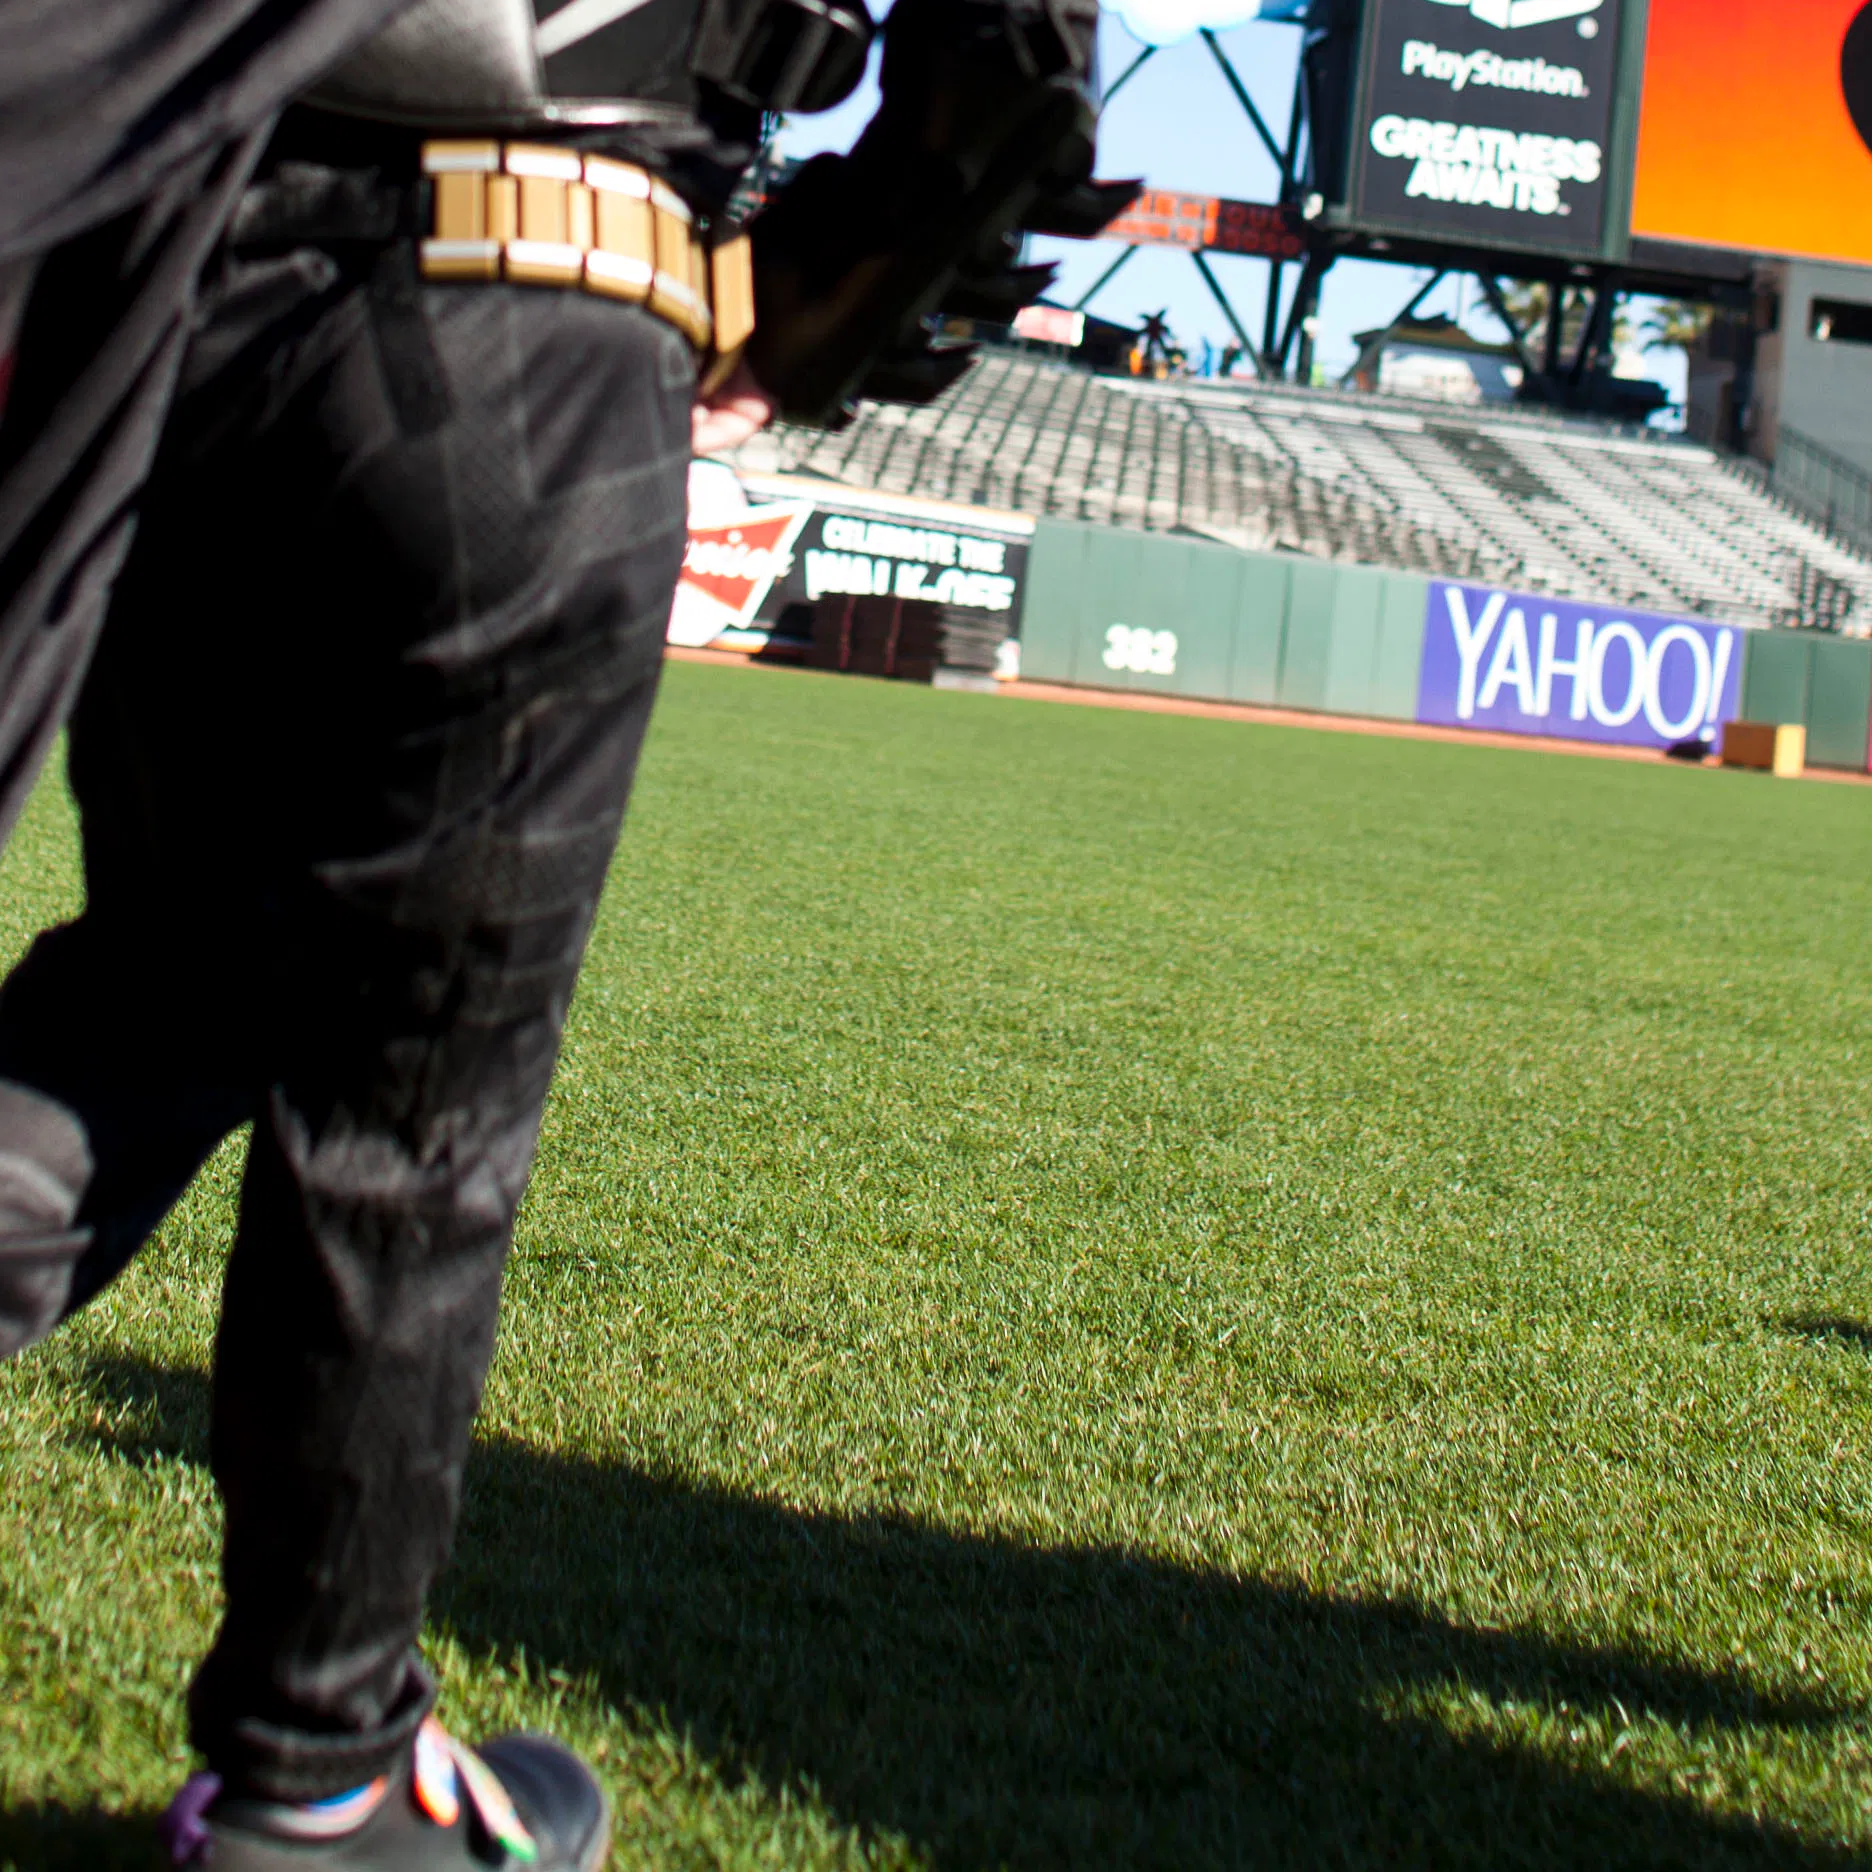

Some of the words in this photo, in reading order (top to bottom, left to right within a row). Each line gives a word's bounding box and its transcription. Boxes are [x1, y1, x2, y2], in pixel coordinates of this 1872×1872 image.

[1401, 39, 1587, 98] PlayStation
[1369, 114, 1602, 183] GREATNESS
[822, 514, 957, 566] CELEBRATE
[958, 535, 1007, 573] THE
[1443, 584, 1733, 742] YAHOO!
